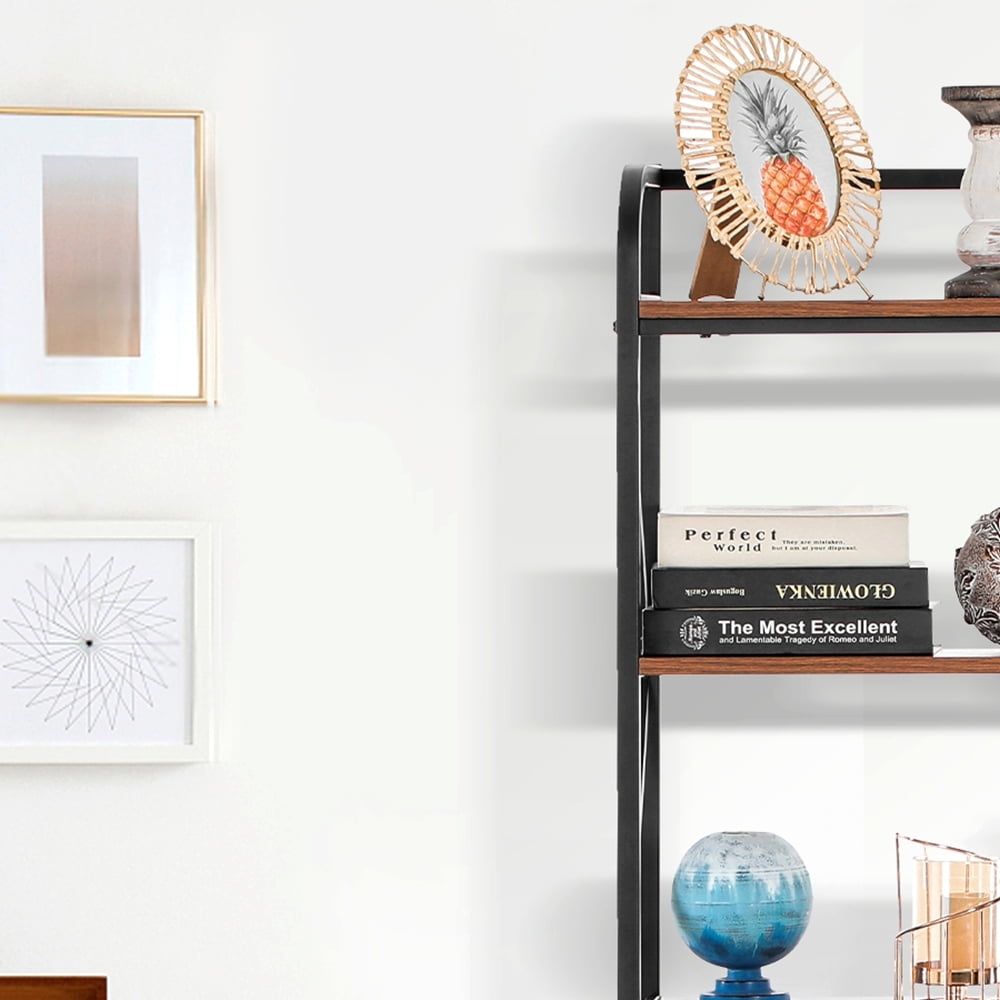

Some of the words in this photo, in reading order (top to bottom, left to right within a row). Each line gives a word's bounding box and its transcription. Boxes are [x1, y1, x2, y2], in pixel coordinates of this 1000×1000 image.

[685, 528, 778, 541] Perfect
[713, 542, 762, 552] World
[775, 584, 896, 599] GŁOWIENKA
[718, 620, 754, 635] The
[759, 620, 806, 635] Most
[811, 620, 898, 635] Excellent
[719, 636, 734, 644] and
[736, 636, 782, 644] Lamentable
[784, 636, 817, 645] Tragedy
[818, 636, 827, 644] of
[828, 636, 858, 644] Romeo
[858, 636, 874, 644] and
[876, 636, 898, 644] Juliet
